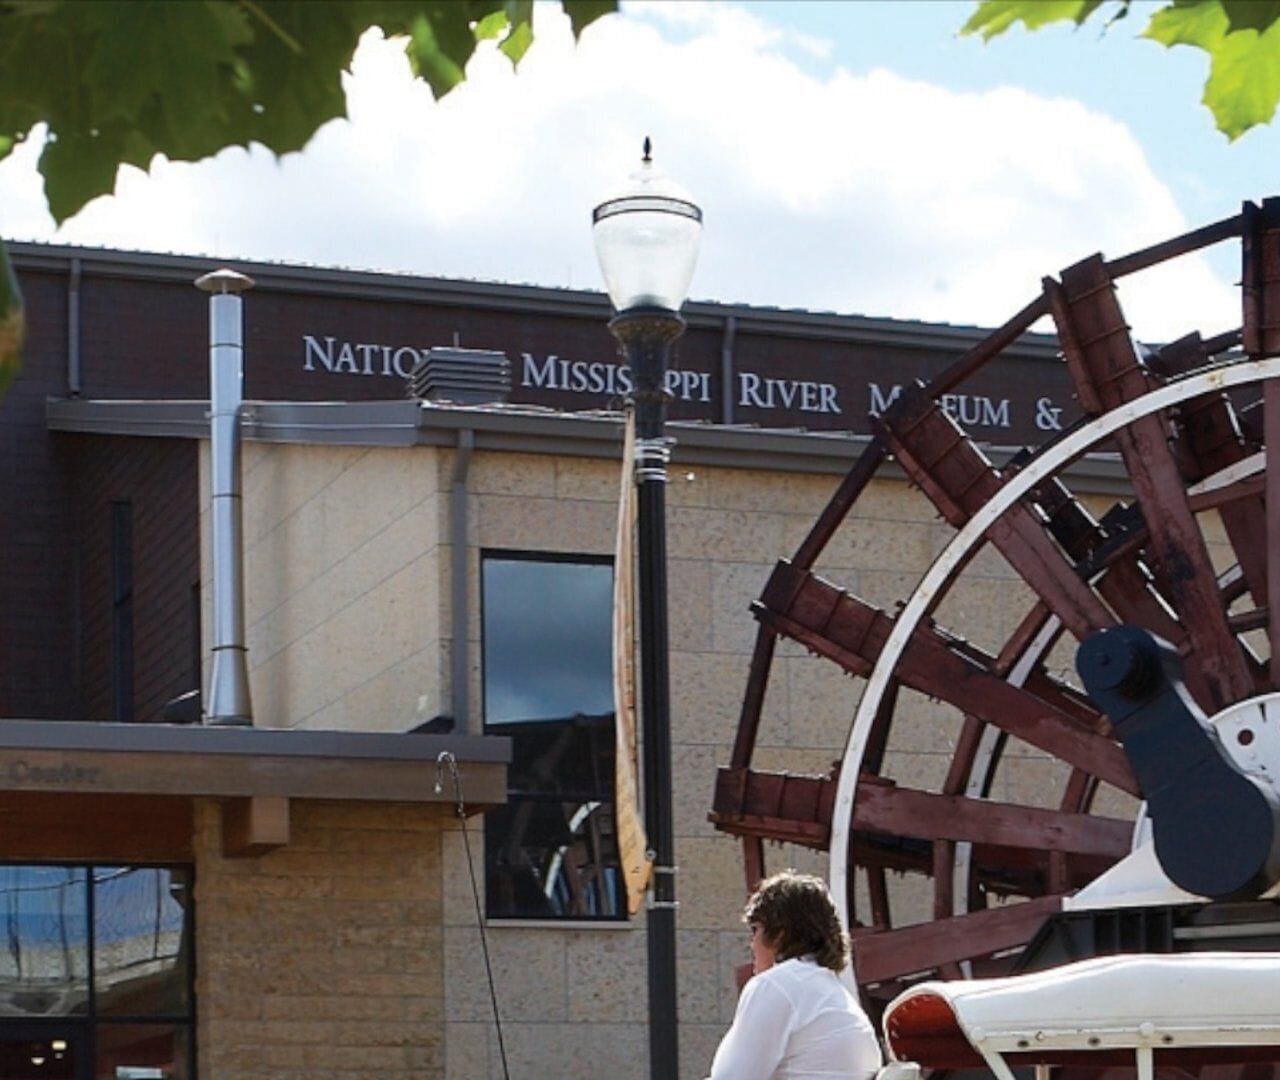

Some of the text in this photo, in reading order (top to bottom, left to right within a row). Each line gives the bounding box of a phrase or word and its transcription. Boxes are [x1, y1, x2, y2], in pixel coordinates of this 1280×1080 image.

[302, 335, 1063, 430] NATIO MISSISPPI RIVER MEUM &
[7, 761, 100, 784] Center
